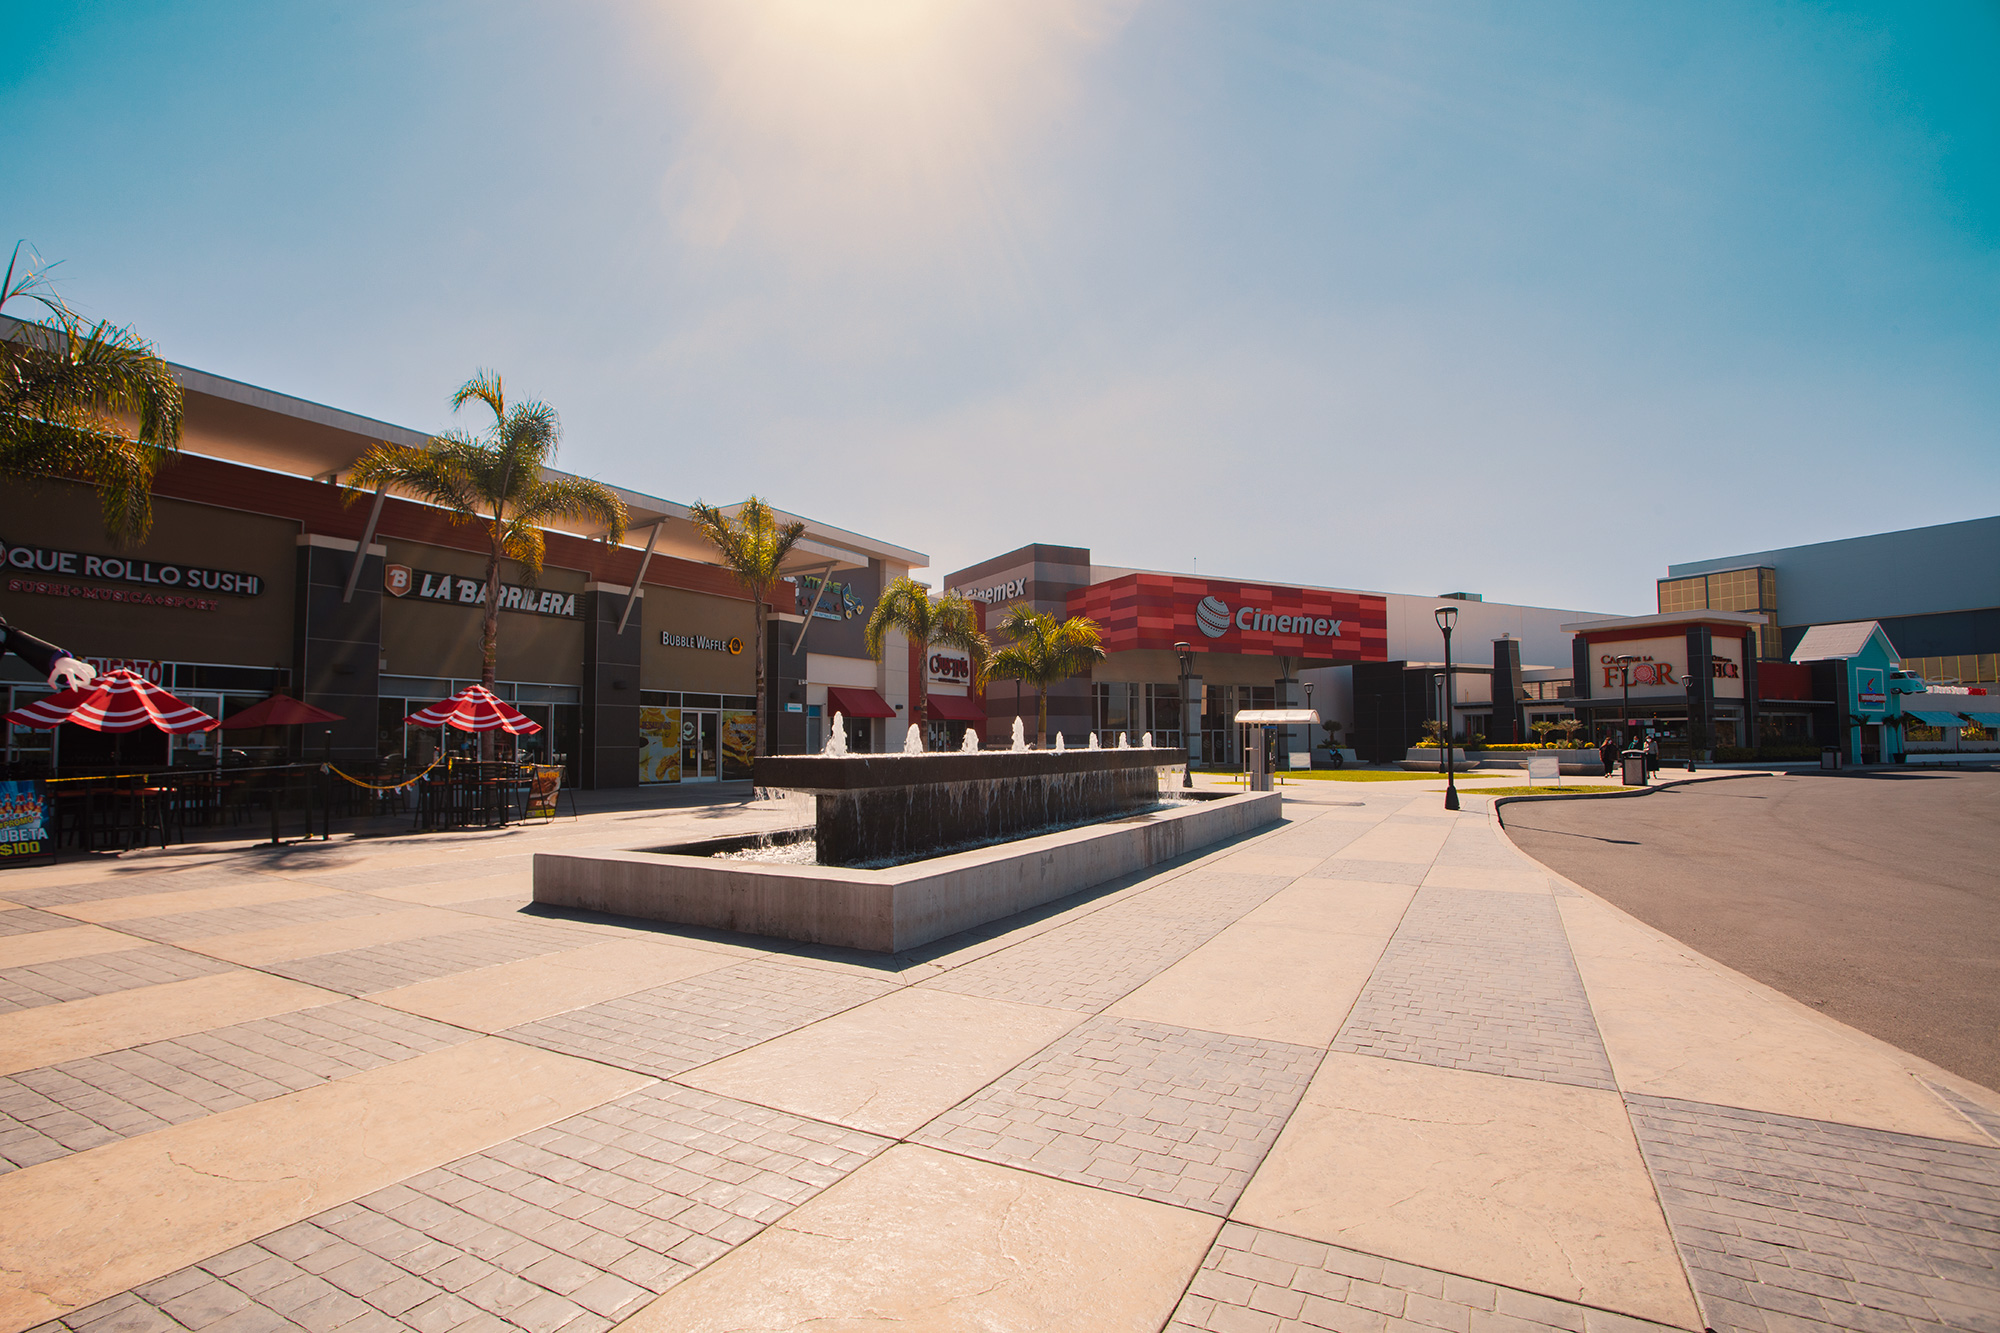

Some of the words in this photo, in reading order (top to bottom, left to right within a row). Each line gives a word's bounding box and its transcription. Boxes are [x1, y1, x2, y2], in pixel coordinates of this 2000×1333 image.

[8, 547, 77, 573] QUE
[84, 555, 181, 587] ROLLO
[187, 568, 258, 594] SUSHI
[419, 573, 452, 600] LA
[1235, 606, 1342, 637] Cinemex
[0, 841, 41, 856] $100
